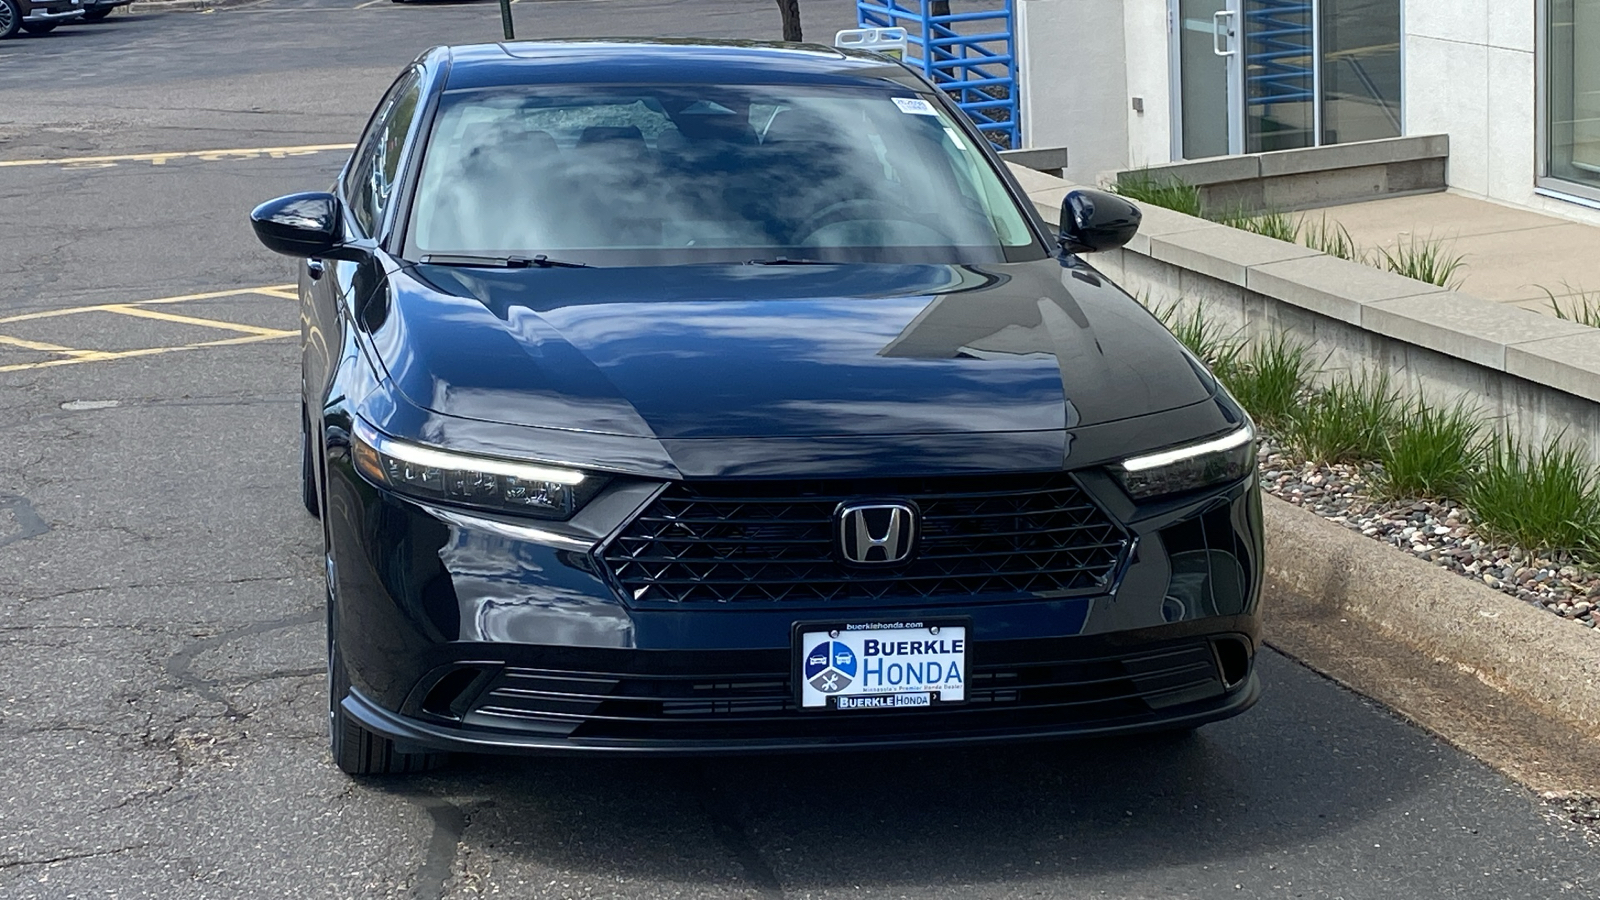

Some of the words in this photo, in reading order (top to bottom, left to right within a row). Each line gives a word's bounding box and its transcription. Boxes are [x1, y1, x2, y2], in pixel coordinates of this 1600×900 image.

[846, 621, 923, 631] buerklehonda.com
[863, 639, 964, 657] BUERKLE
[862, 658, 963, 687] HONDA
[839, 696, 894, 708] BUERKLE
[896, 695, 928, 705] HONDA
